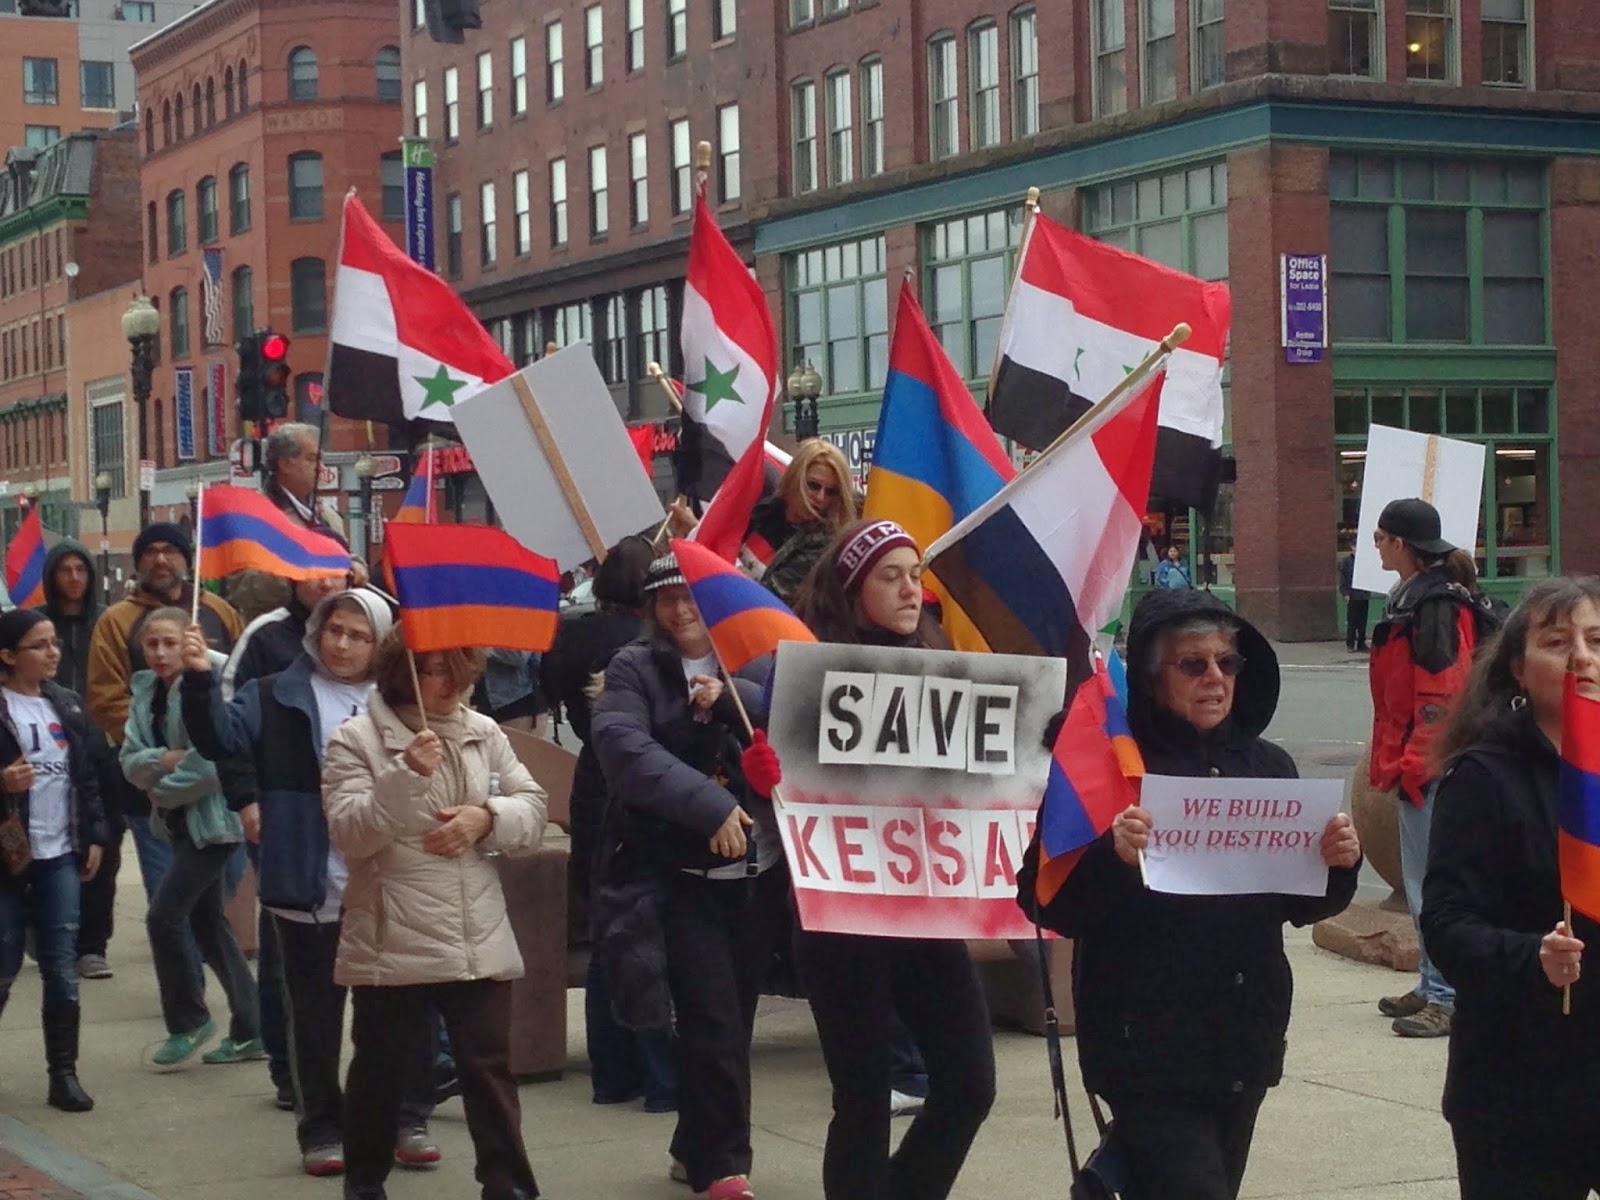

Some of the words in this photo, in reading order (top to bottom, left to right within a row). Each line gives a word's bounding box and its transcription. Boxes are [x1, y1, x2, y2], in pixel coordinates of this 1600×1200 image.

[414, 171, 427, 207] Holiday
[416, 223, 426, 254] Express
[1288, 257, 1320, 270] Office
[1288, 268, 1320, 281] Space
[828, 684, 1012, 763] SAVE
[1183, 798, 1222, 818] WE
[1227, 799, 1303, 819] BUILD
[786, 814, 1037, 887] KESSA
[1152, 829, 1200, 849] YOU
[1206, 829, 1319, 849] DESTROY
